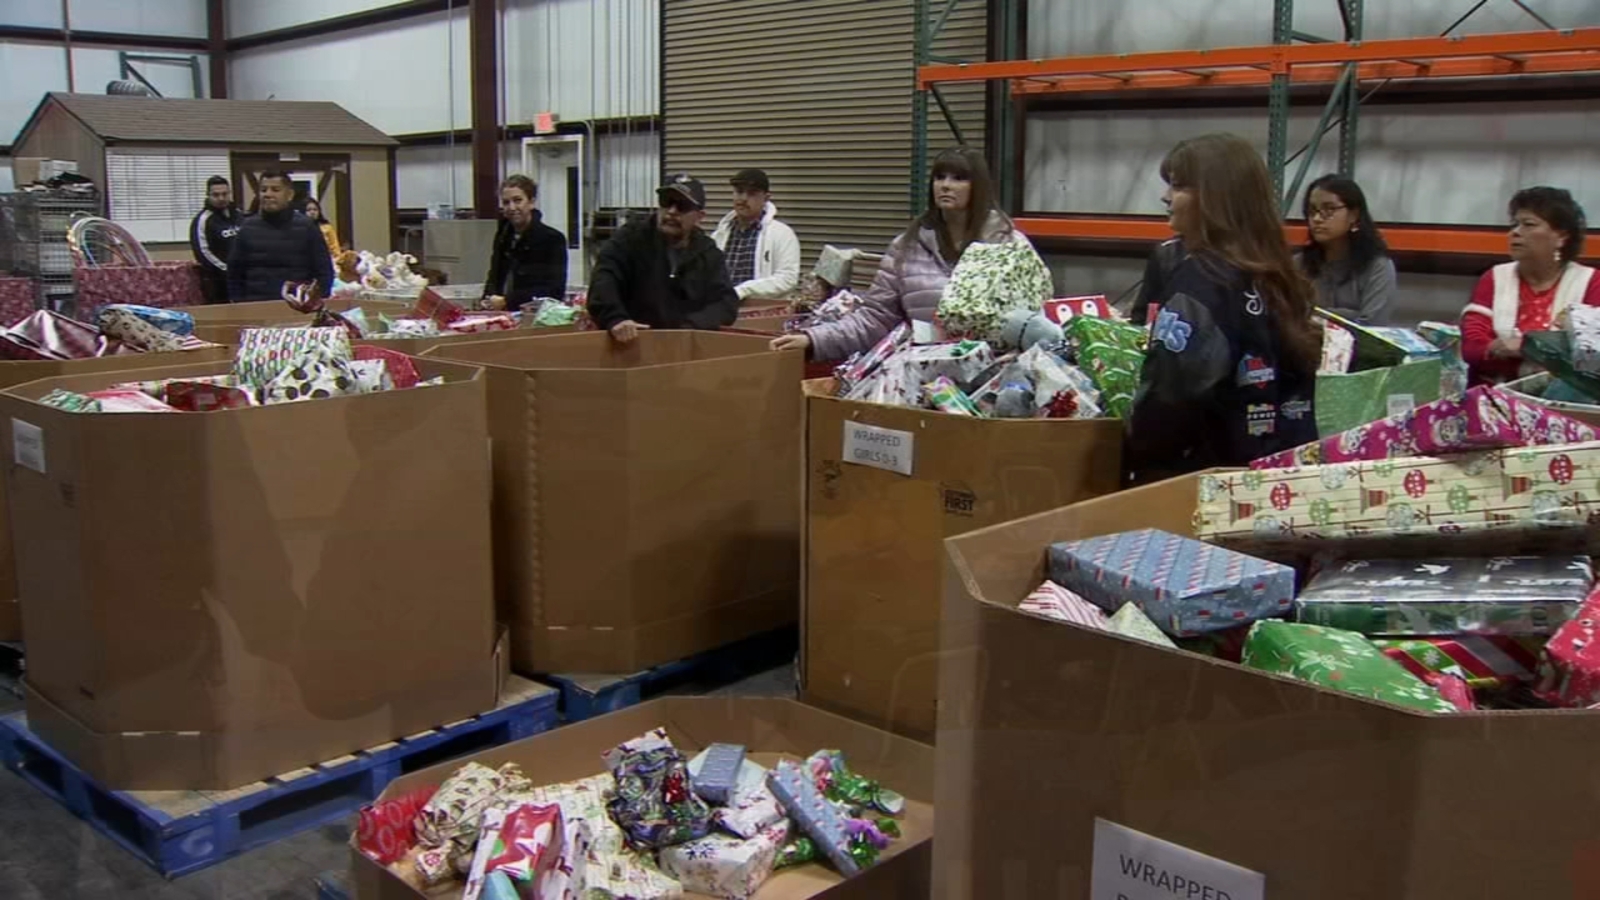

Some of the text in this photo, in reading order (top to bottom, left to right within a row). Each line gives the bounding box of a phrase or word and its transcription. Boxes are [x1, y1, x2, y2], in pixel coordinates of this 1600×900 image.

[854, 429, 901, 447] WRAPPED
[854, 448, 880, 462] GIRLS
[945, 496, 974, 511] FIRST
